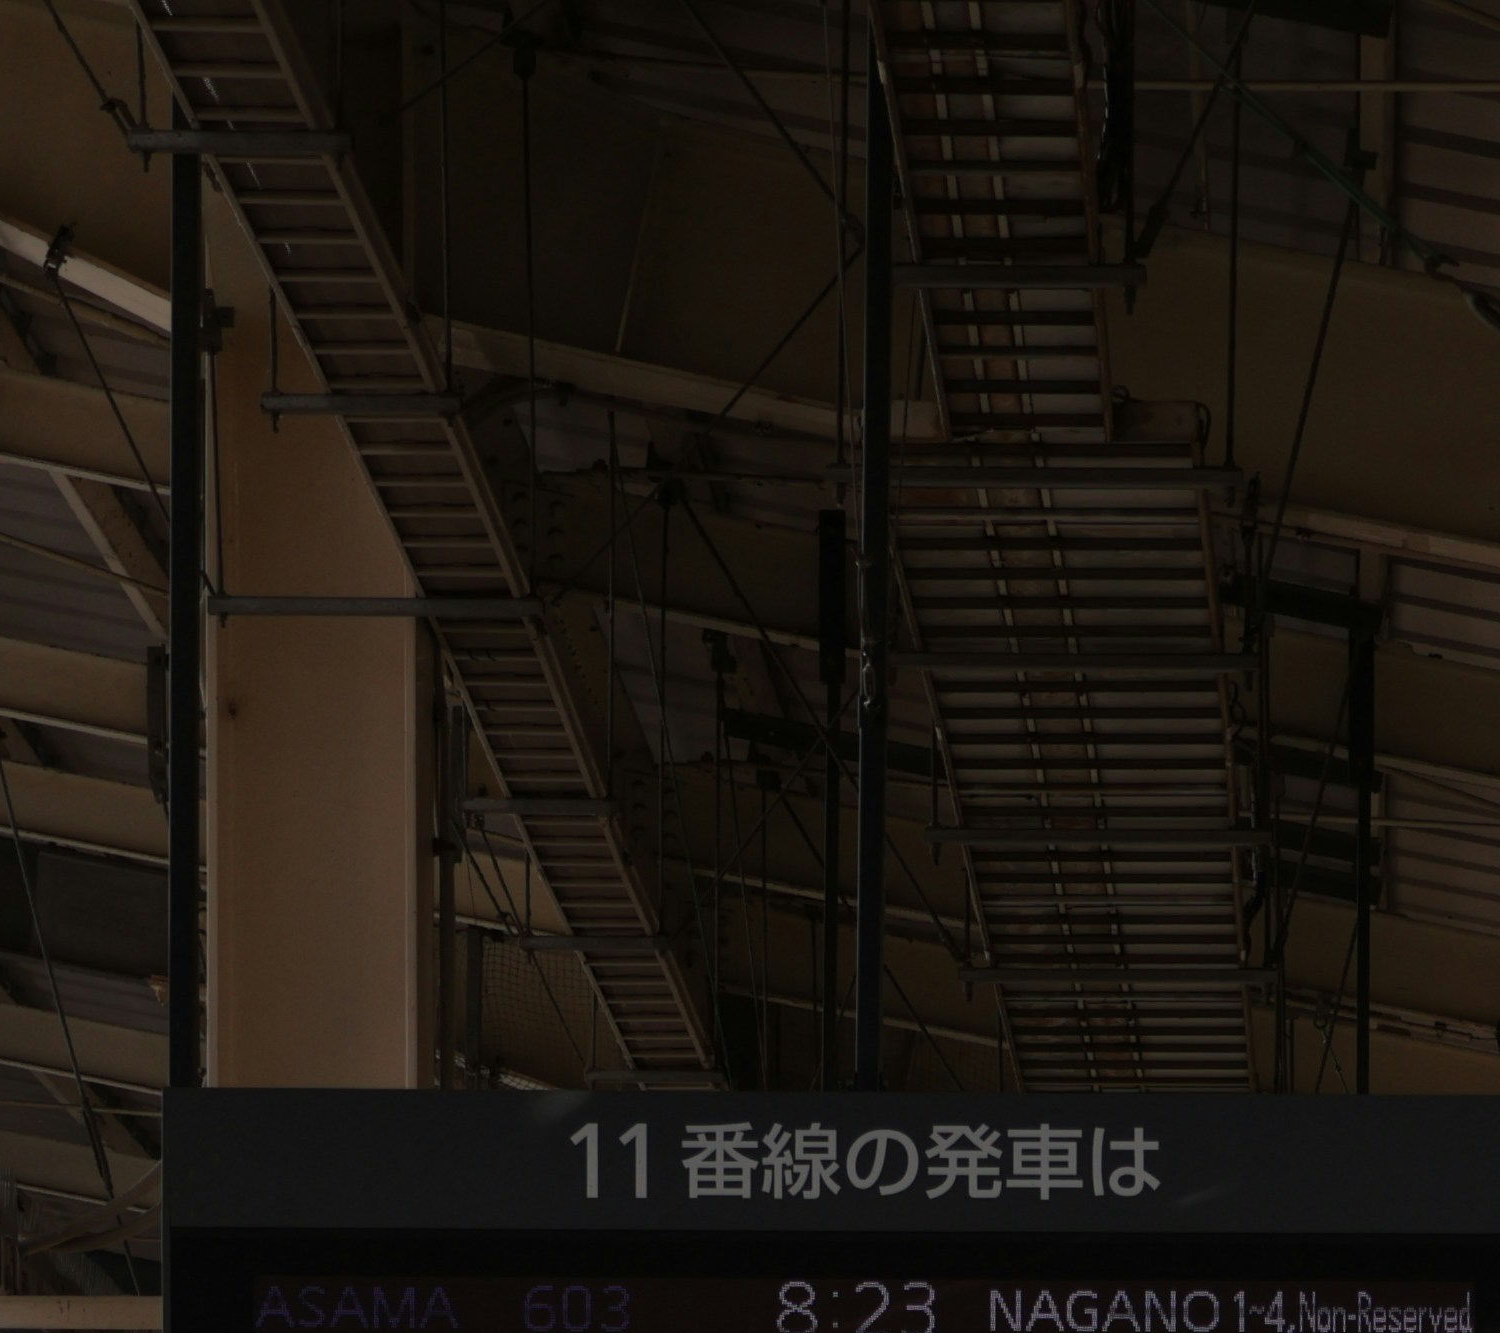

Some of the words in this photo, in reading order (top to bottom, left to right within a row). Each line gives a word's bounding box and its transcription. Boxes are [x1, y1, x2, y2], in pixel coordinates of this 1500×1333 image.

[255, 1285, 460, 1329] ASAMA
[524, 1285, 631, 1332] 603
[988, 1289, 1220, 1333] NAGANO
